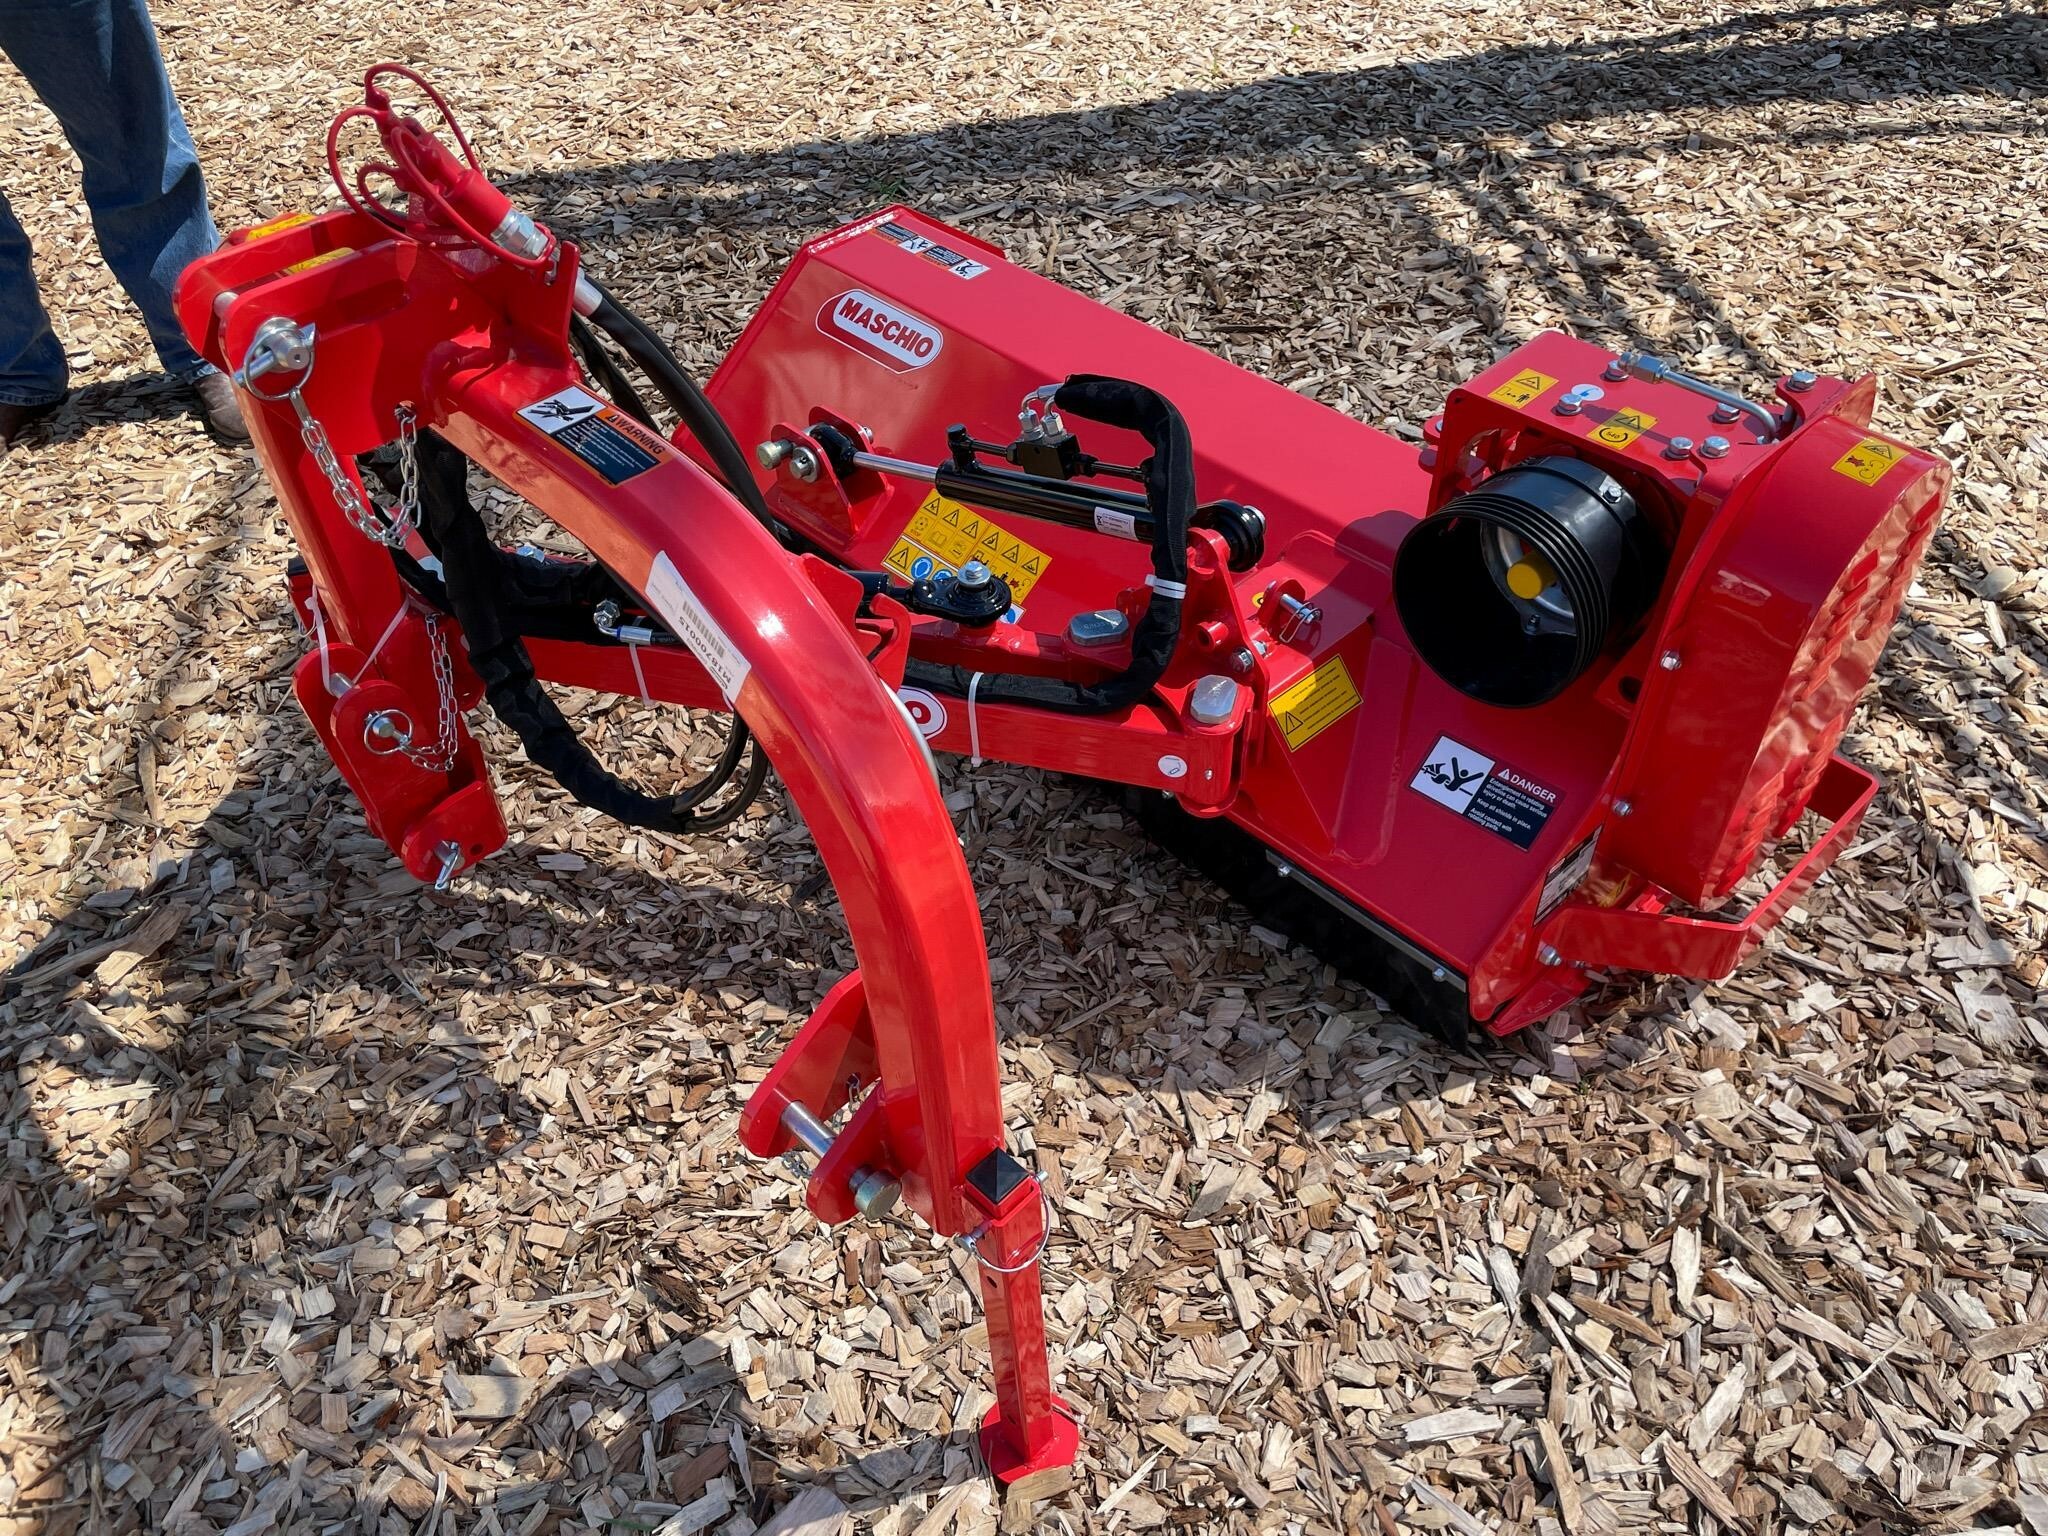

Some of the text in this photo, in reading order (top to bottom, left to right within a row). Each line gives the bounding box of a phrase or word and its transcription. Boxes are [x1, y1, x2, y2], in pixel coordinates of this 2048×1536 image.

[839, 298, 934, 358] MASCHIO
[616, 417, 666, 454] WARNING
[679, 616, 732, 683] M18700015
[1510, 774, 1556, 803] DANGER
